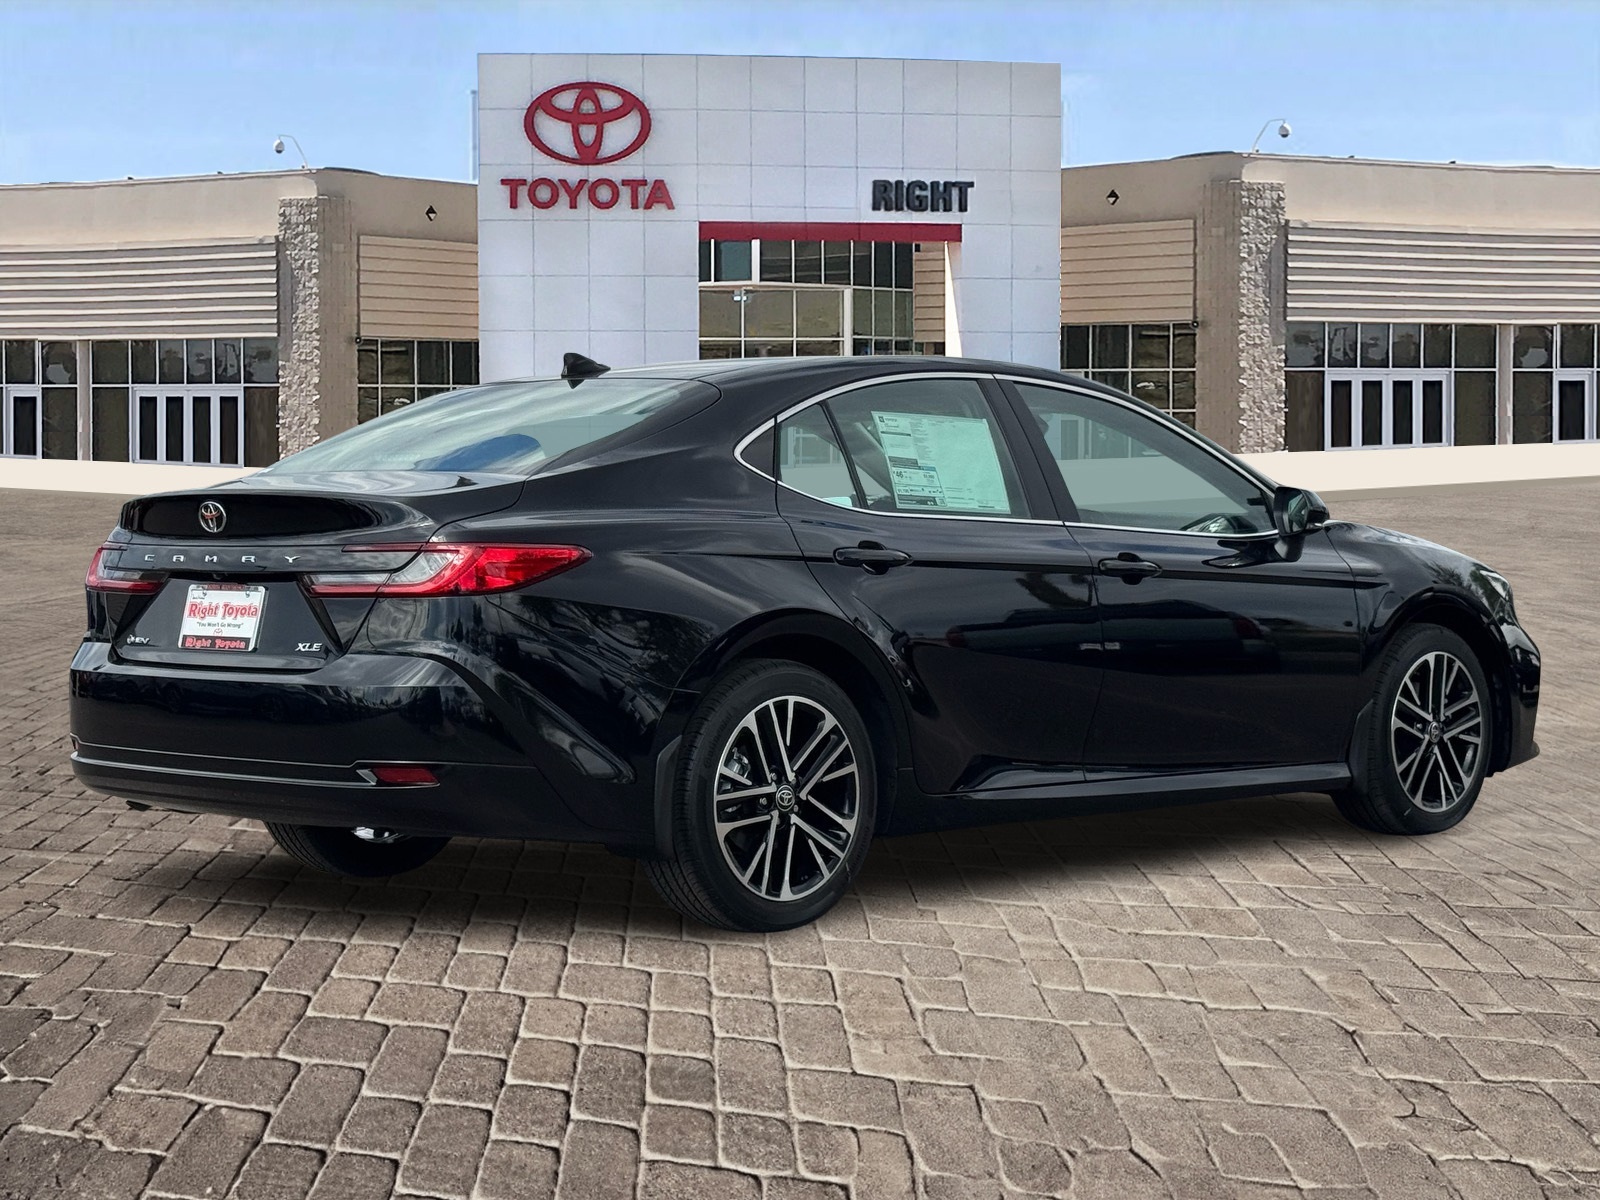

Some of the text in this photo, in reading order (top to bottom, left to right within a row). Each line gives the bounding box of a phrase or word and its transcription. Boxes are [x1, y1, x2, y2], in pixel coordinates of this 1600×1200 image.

[501, 178, 675, 210] TOYOTA
[871, 180, 975, 213] RIGHT
[144, 554, 301, 564] CAMRY
[188, 603, 259, 620] Right Toyota
[185, 636, 246, 649] Right Toyota
[295, 642, 322, 651] XLE
